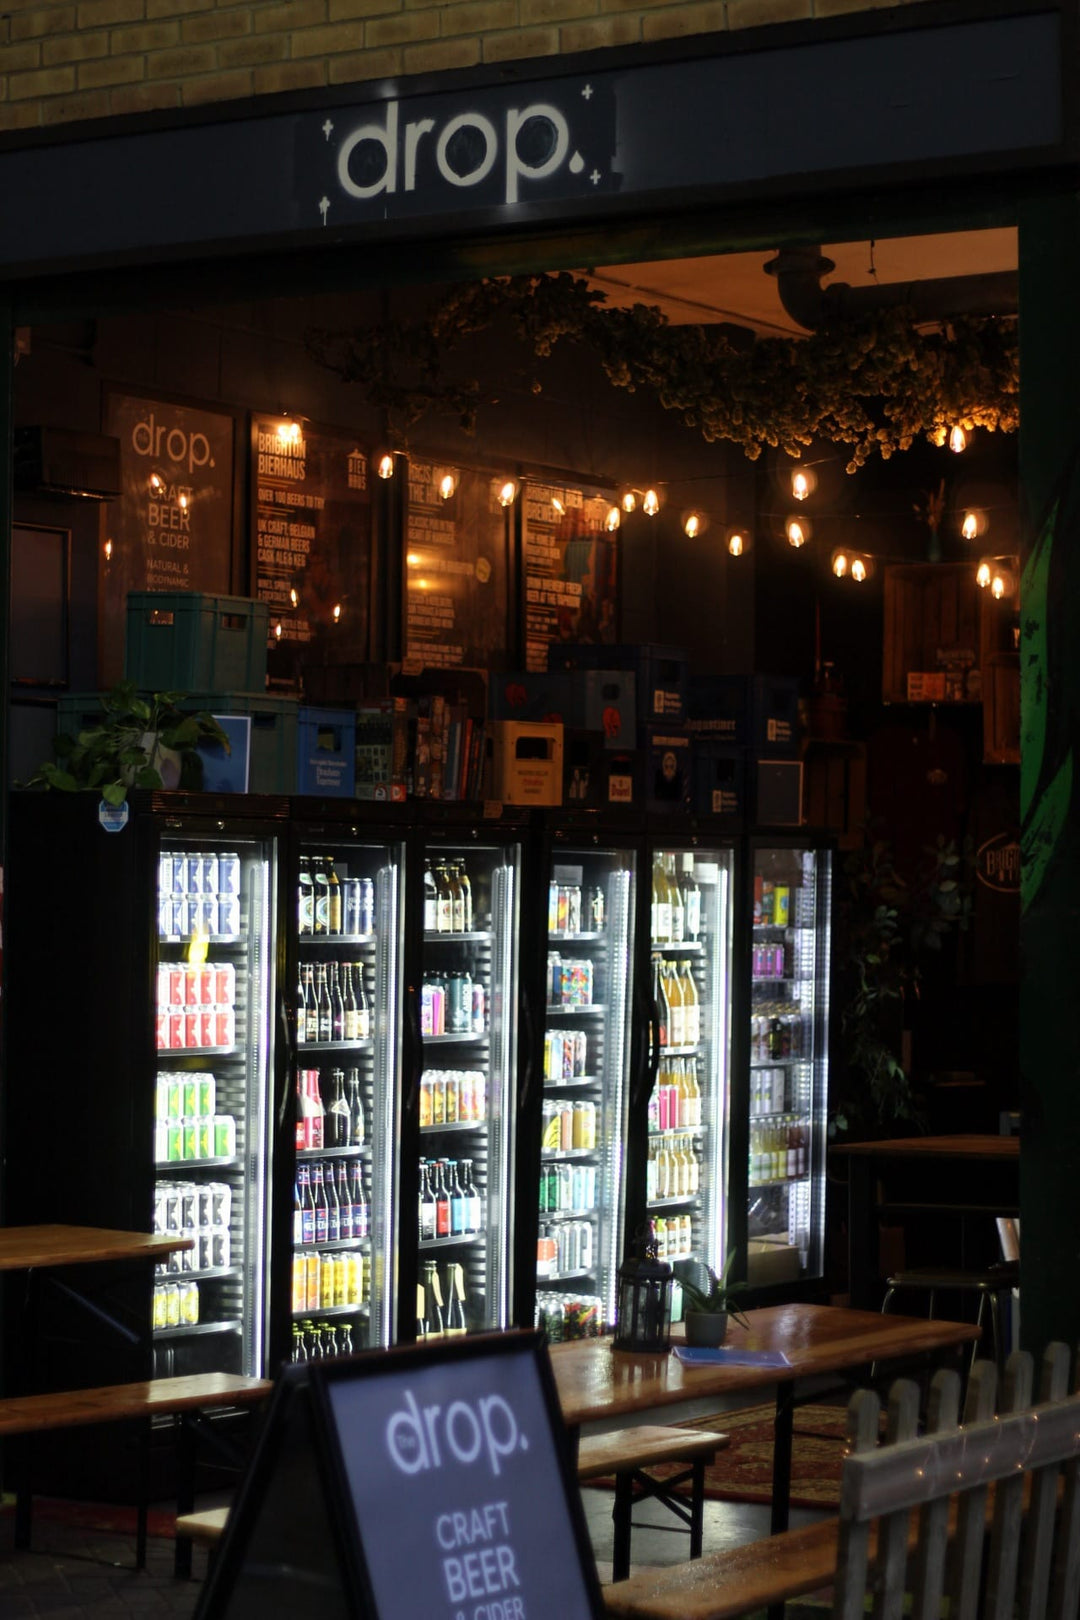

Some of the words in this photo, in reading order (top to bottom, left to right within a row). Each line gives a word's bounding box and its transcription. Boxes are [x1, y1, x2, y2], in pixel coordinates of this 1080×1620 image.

[338, 99, 585, 205] drop.
[131, 413, 216, 474] drop.
[257, 453, 306, 480] BIERHAUS
[147, 530, 157, 545] &
[159, 532, 190, 550] CIDER
[148, 503, 191, 533] BEER
[146, 559, 182, 574] NATURAL
[385, 1388, 529, 1476] drop.
[435, 1500, 509, 1550] CRAFT
[443, 1545, 521, 1604] BEER
